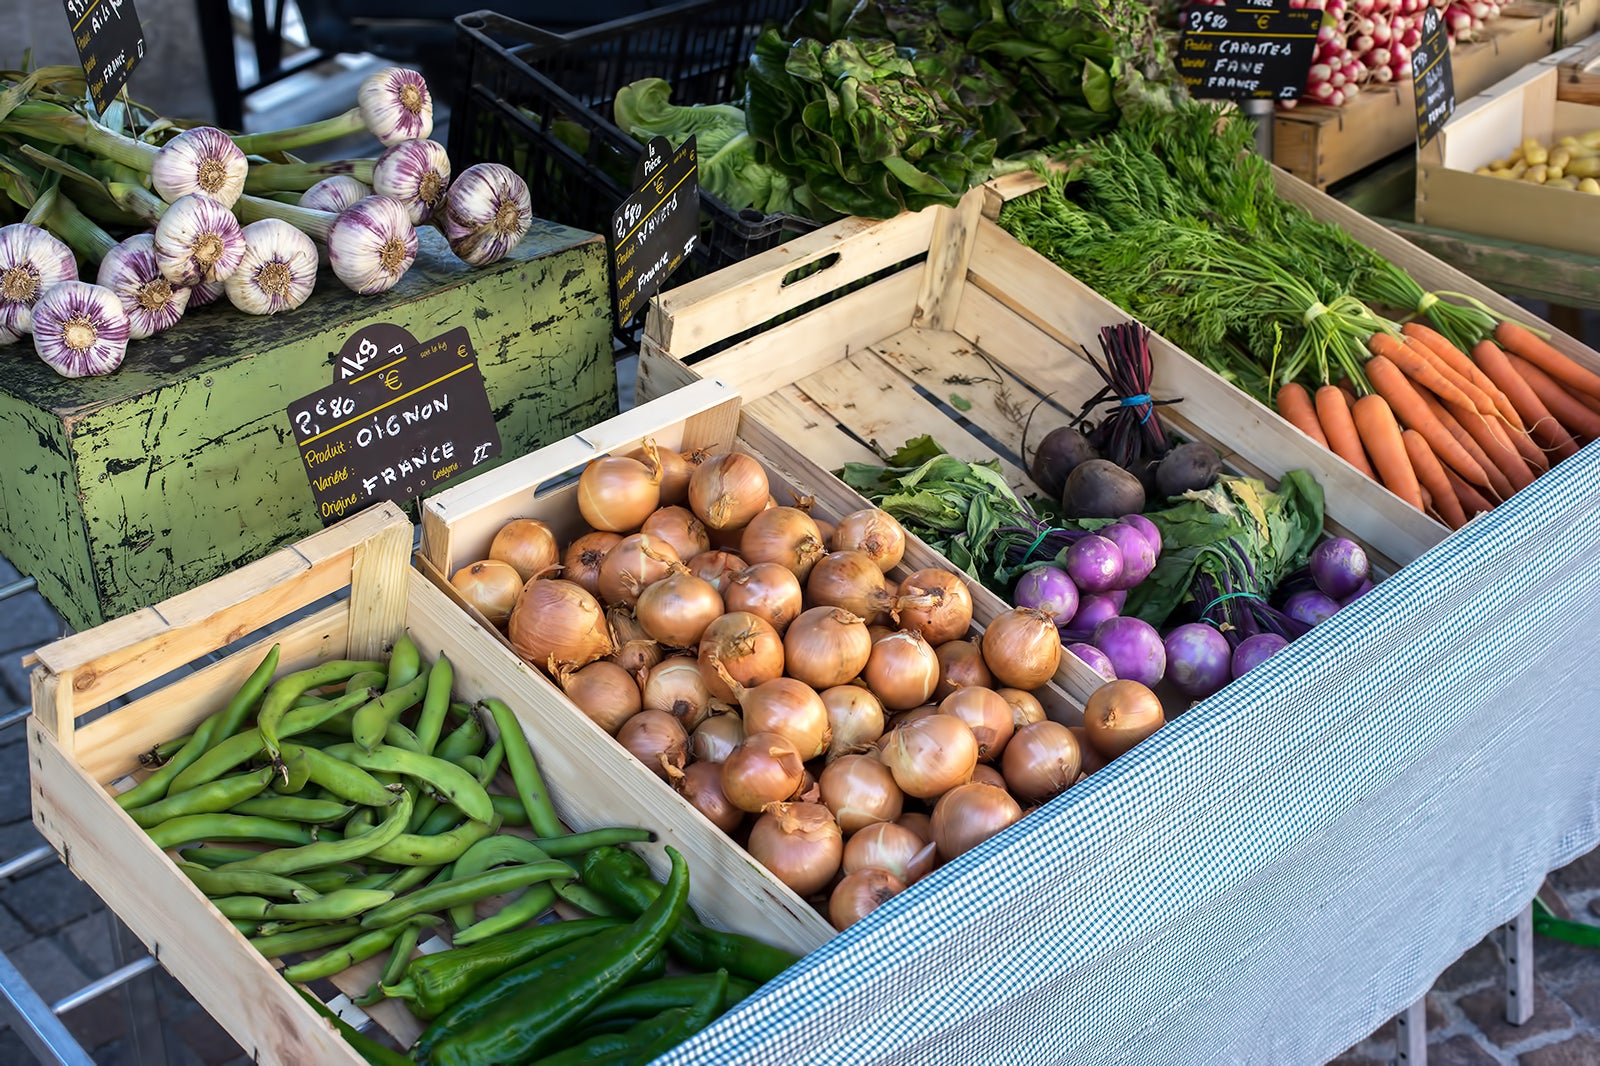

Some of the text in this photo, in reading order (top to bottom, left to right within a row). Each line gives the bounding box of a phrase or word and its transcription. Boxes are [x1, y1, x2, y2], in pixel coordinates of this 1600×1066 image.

[1214, 58, 1264, 74] FANE
[644, 155, 662, 177] Pièce
[385, 369, 403, 390] €
[305, 440, 346, 468] Produit
[313, 465, 349, 492] Variété
[321, 494, 358, 517] Origine
[363, 441, 455, 496] FRANCE
